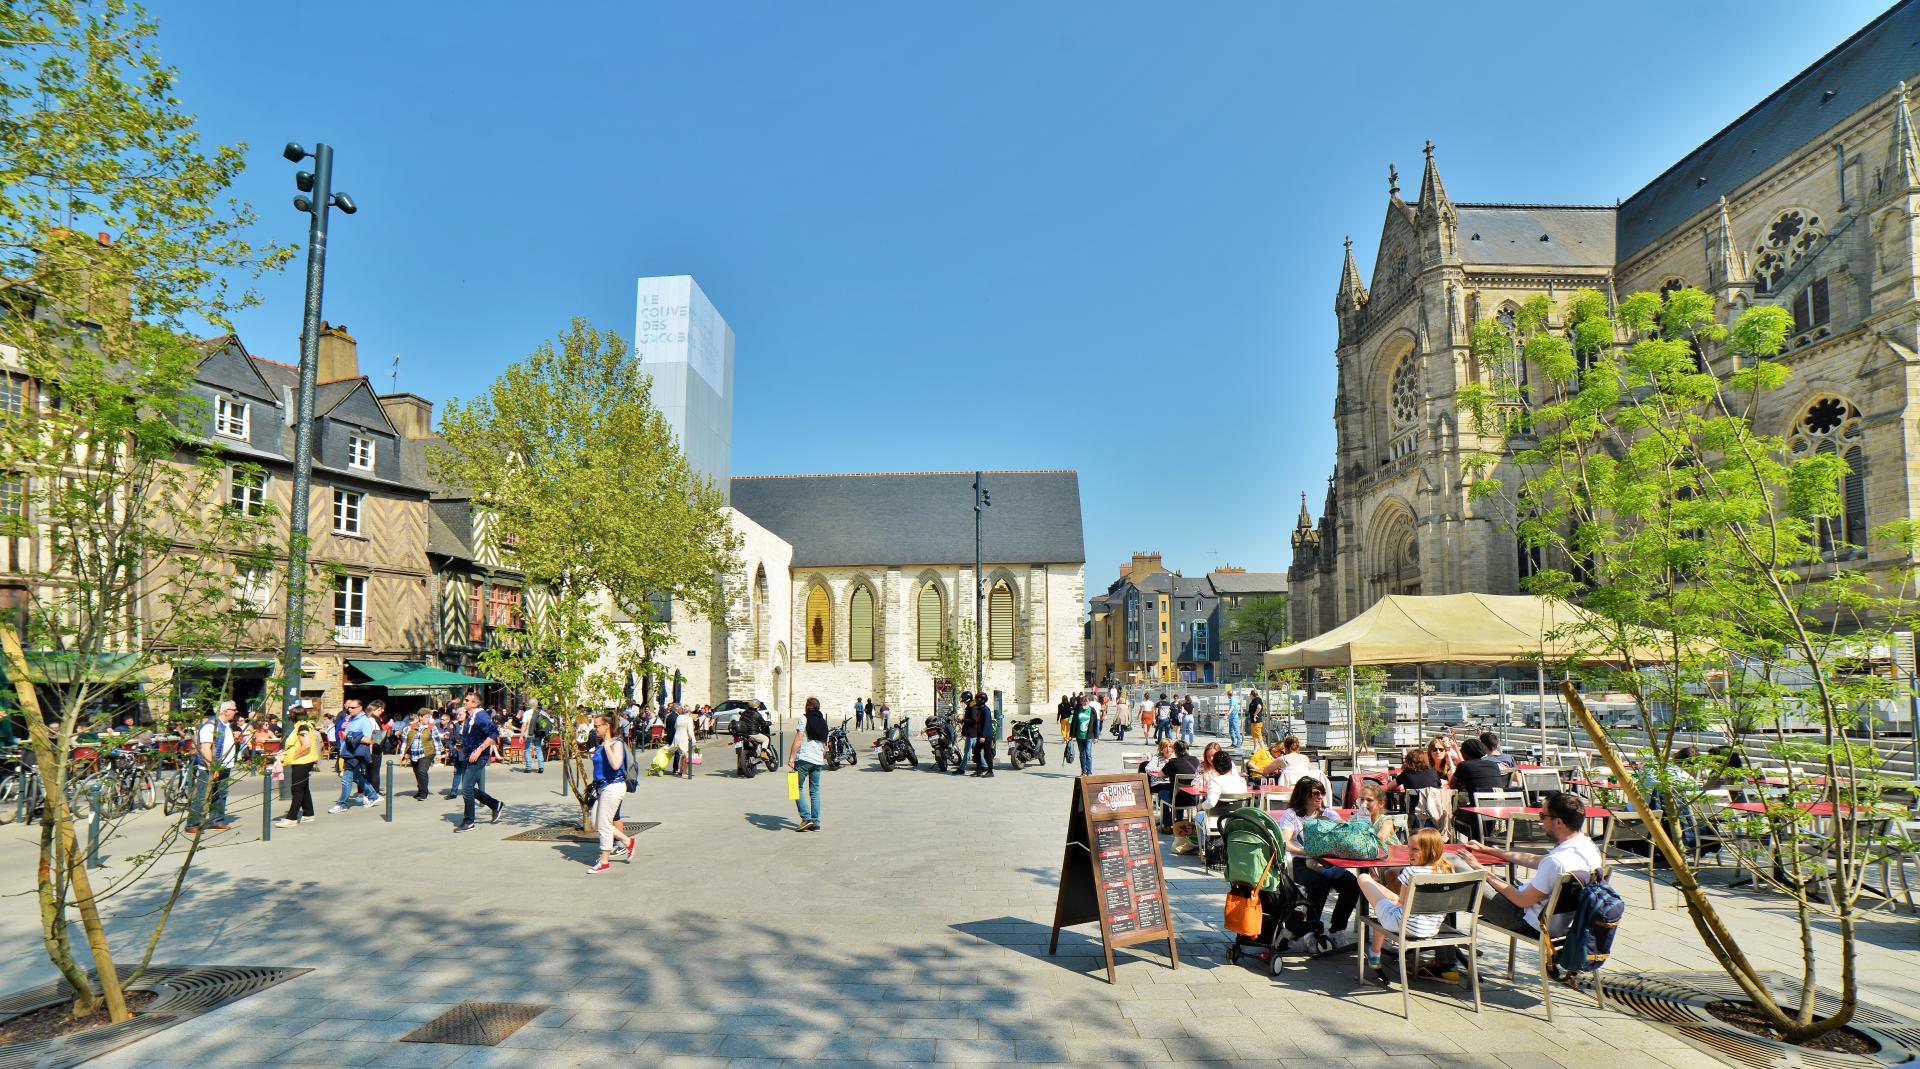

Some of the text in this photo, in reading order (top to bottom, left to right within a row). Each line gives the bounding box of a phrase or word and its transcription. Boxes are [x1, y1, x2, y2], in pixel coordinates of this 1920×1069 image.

[642, 295, 660, 305] LE
[643, 320, 666, 331] DES
[1108, 785, 1132, 797] BONNE
